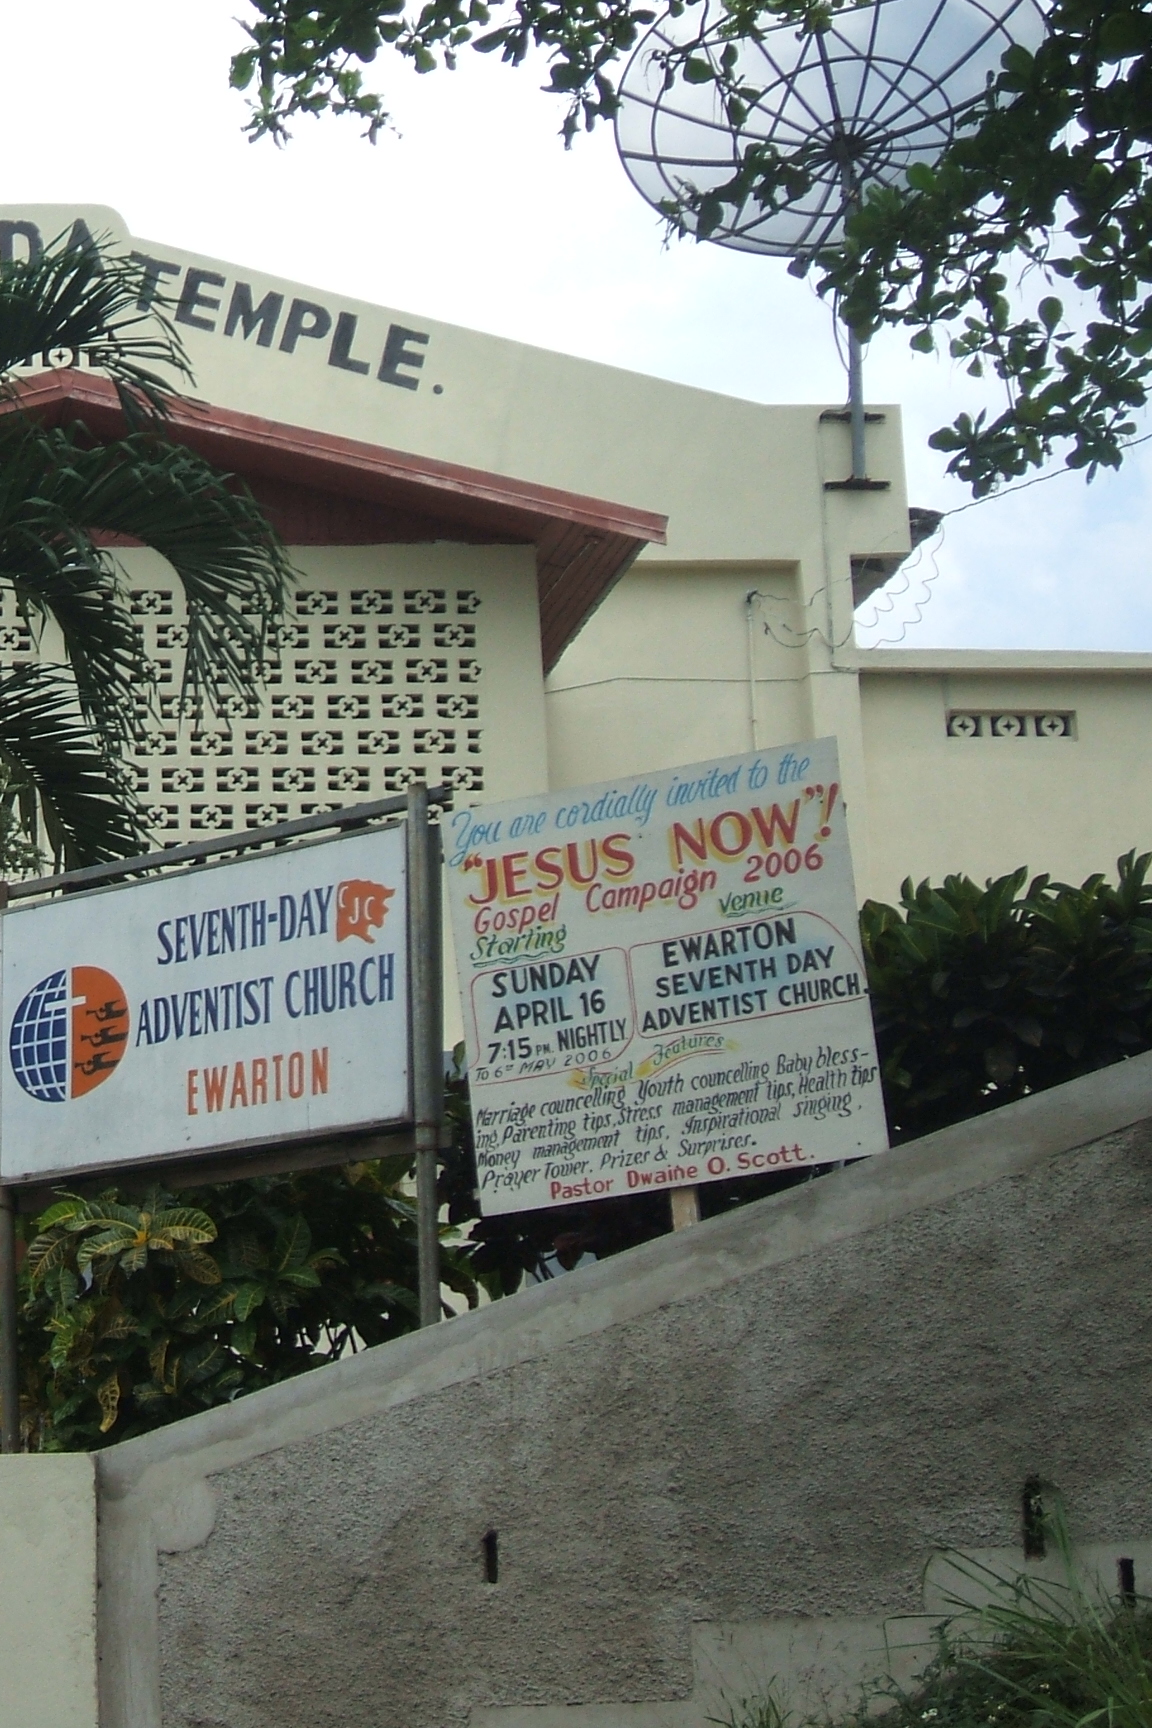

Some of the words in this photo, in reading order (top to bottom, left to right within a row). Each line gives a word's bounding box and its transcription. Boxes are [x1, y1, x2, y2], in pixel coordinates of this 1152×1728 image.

[128, 250, 445, 395] TEMPLE.
[449, 810, 502, 868] You
[509, 811, 547, 839] are
[555, 784, 658, 829] cordially
[666, 764, 742, 806] invited
[748, 758, 768, 790] to
[778, 752, 810, 785] the
[463, 833, 635, 904] "JESUS
[474, 892, 560, 934] Gospel
[586, 868, 717, 912] Campaign
[743, 843, 824, 883] 2006
[156, 885, 334, 965] SEVENTH-DAY
[718, 886, 784, 913] Venue
[470, 924, 567, 961] Starting
[656, 956, 777, 998] SEVENTH
[787, 945, 835, 975] DAY
[662, 917, 797, 967] EWARTON
[136, 976, 274, 1047] ADVENTIST
[284, 953, 395, 1019] CHURCH
[491, 954, 601, 998] SUNDAY
[494, 996, 573, 1034] APRIL
[580, 989, 606, 1017] 16
[642, 989, 768, 1032] ADVENTIST
[487, 1037, 533, 1064] 7:15
[519, 1057, 556, 1074] MAY
[564, 1048, 612, 1067] 2006
[582, 1061, 634, 1089] Special
[653, 1032, 725, 1066] Features
[187, 1046, 329, 1115] EWARTON
[476, 1101, 537, 1128] Marriage
[540, 1085, 626, 1117] councelling
[634, 1073, 684, 1106] Youth
[691, 1060, 770, 1092] councelling
[776, 1053, 813, 1078] Baby
[816, 1045, 870, 1068] bless-
[502, 1117, 576, 1145] Parenting
[618, 1102, 663, 1126] Stress
[673, 1081, 759, 1115] management
[798, 1067, 847, 1095] Health
[851, 1064, 878, 1088] tips
[477, 1149, 521, 1171] Money
[532, 1130, 621, 1161] management
[681, 1101, 781, 1137] Inspirational
[482, 1167, 541, 1194] Prayer
[600, 1148, 650, 1171] Prizes
[654, 1144, 668, 1161] &
[677, 1133, 757, 1160] Surprises.
[550, 1177, 614, 1200] Pastor
[627, 1164, 698, 1188] Dwaine
[707, 1156, 730, 1175] O.
[737, 1143, 815, 1170] Scott.
